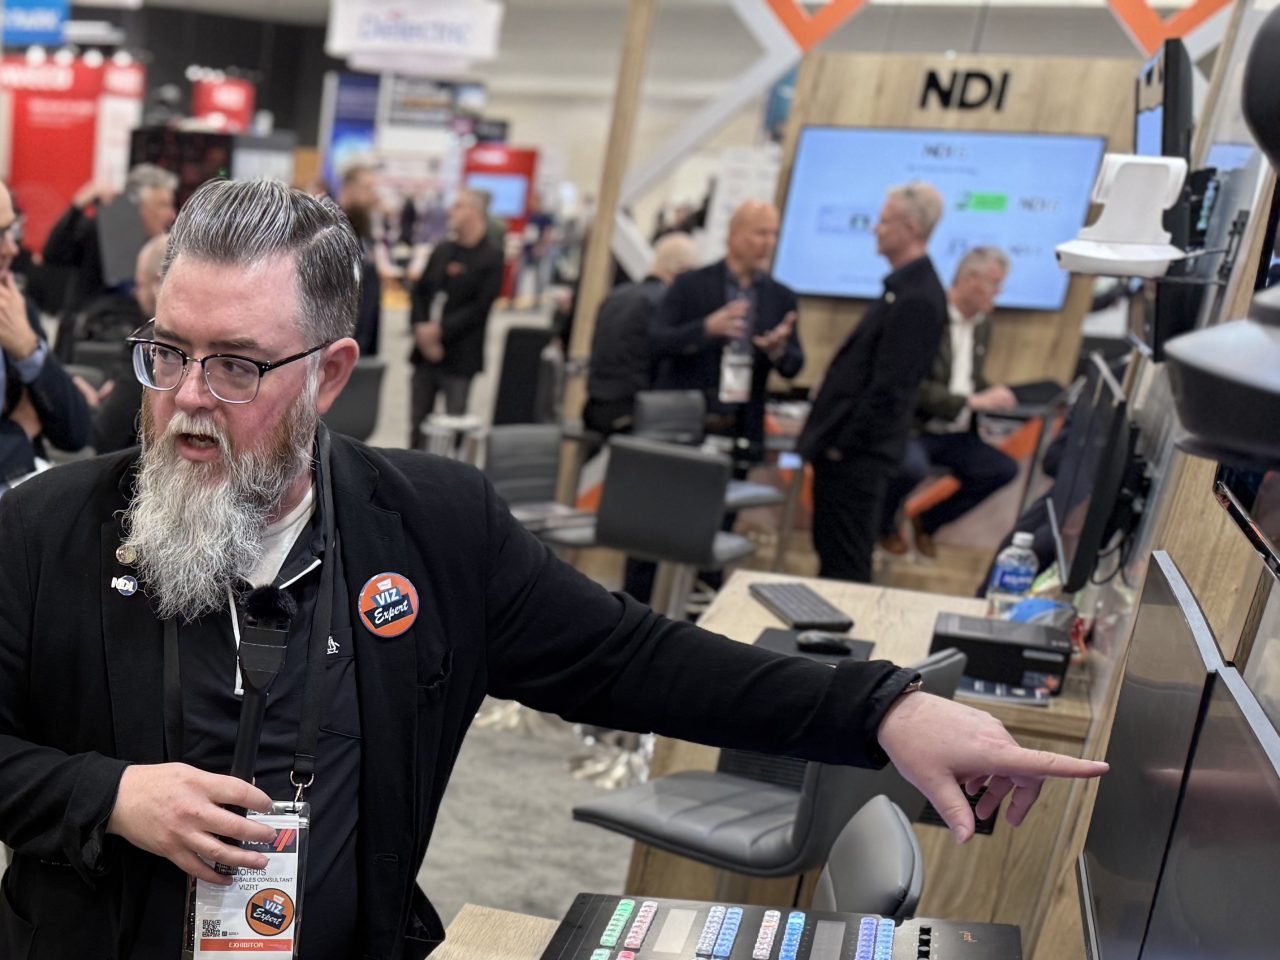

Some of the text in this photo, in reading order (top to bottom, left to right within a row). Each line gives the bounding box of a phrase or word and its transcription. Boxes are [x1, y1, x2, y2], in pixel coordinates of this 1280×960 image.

[919, 69, 1010, 112] NDI
[375, 587, 399, 606] VIZ
[374, 600, 409, 624] Expert
[253, 907, 282, 925] Expert
[265, 900, 283, 914] VIZ
[228, 941, 264, 949] EXHIBITOR
